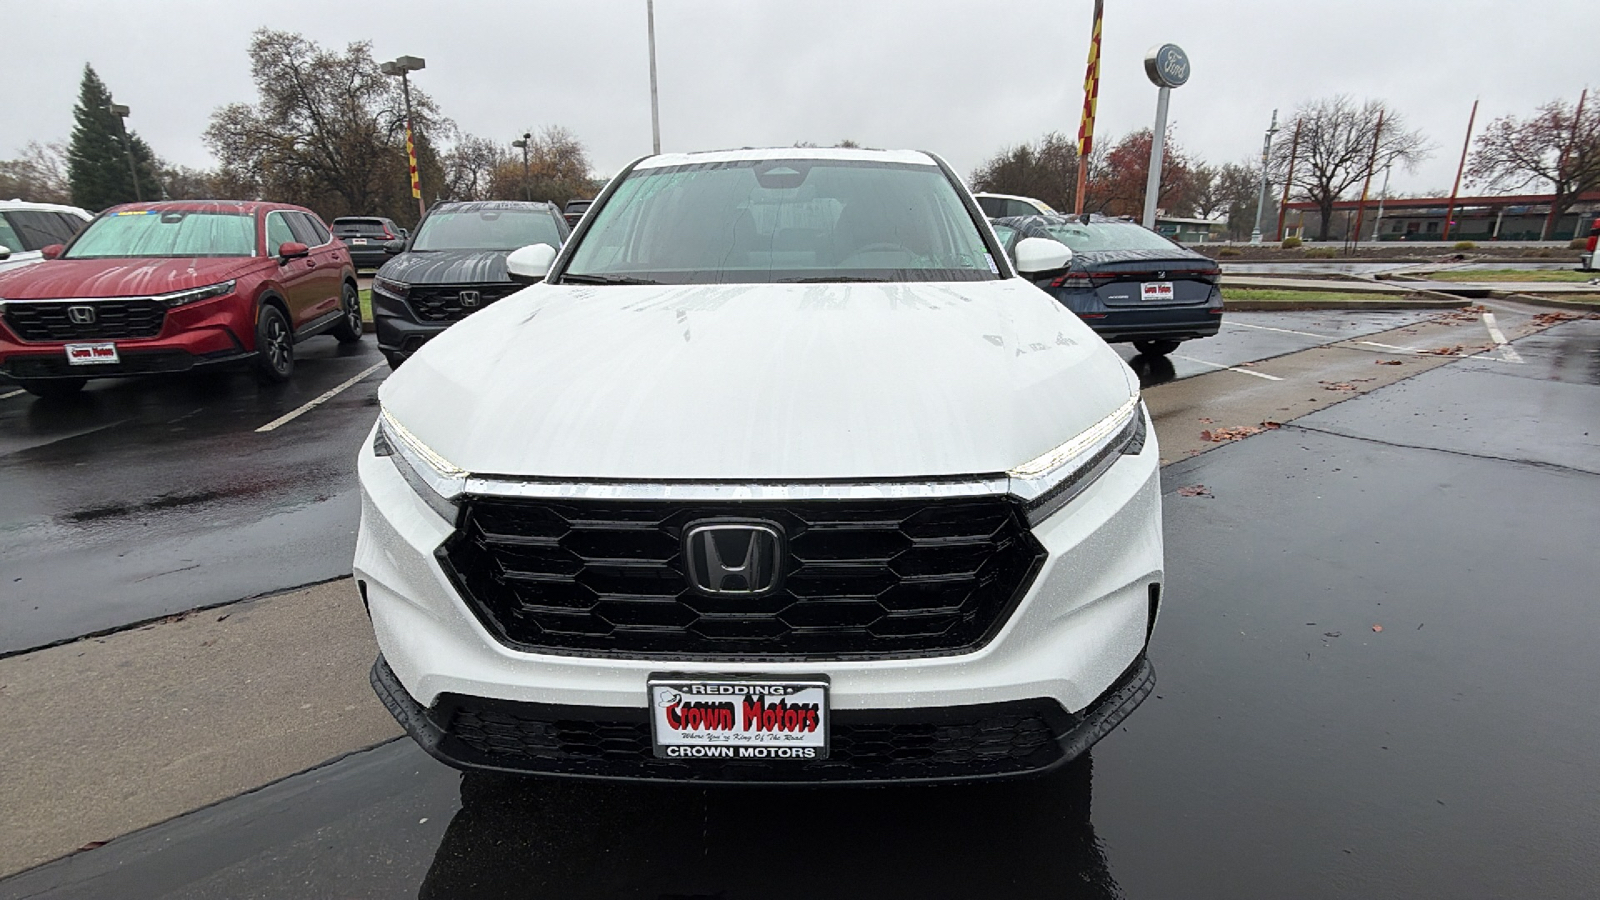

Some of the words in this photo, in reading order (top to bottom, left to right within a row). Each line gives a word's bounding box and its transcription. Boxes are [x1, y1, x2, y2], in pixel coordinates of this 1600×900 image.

[1164, 50, 1187, 79] Ford
[691, 685, 785, 695] REDDING
[665, 694, 736, 731] Crown
[742, 694, 820, 733] Motors
[733, 733, 752, 741] King
[754, 733, 765, 742] Of
[666, 746, 734, 757] CROWN
[739, 747, 816, 758] MOTORS
